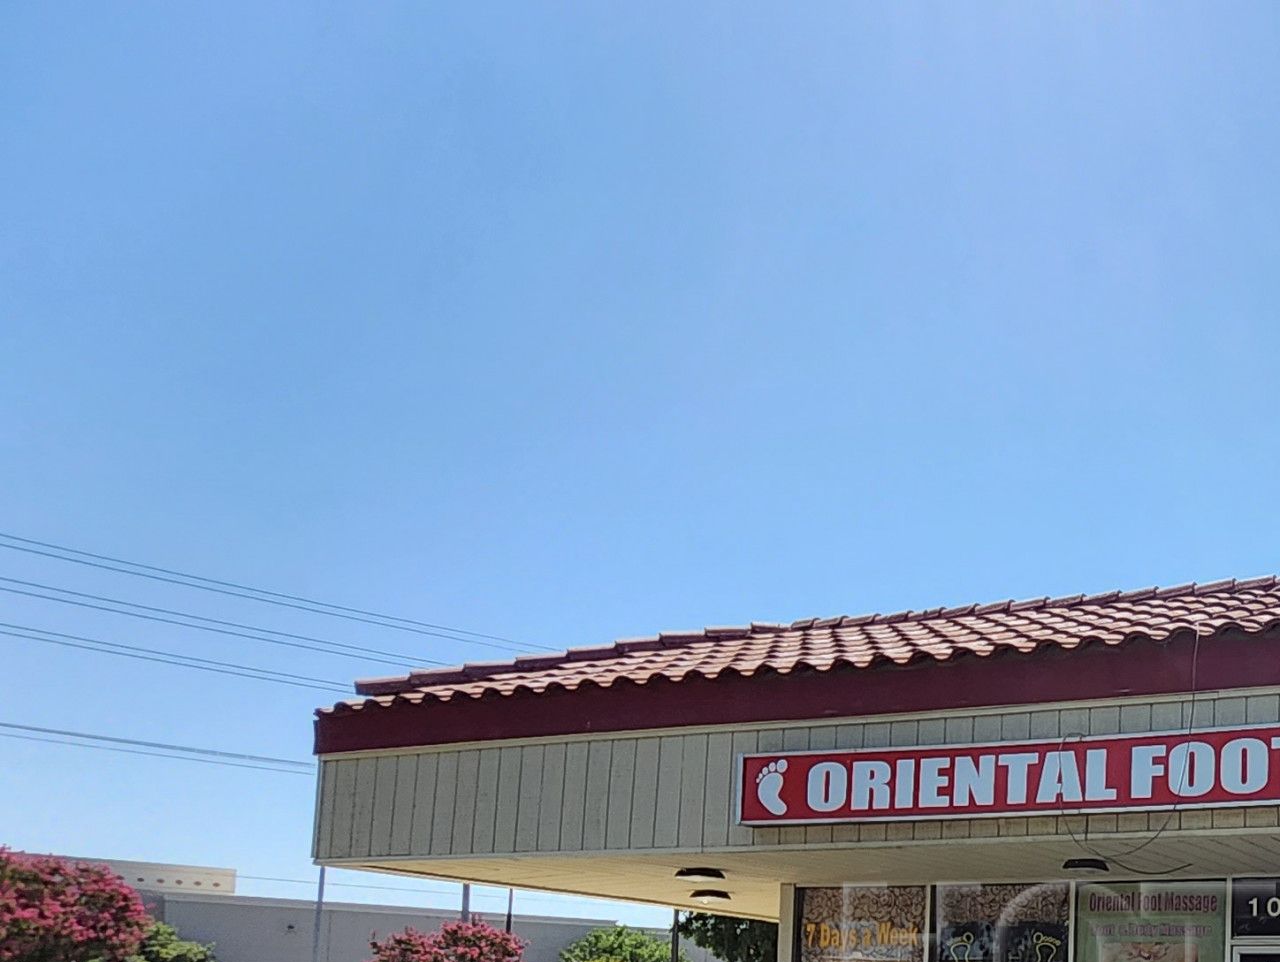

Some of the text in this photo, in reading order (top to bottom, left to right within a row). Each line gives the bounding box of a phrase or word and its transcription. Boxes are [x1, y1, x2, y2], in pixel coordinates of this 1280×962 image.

[807, 749, 1117, 812] ORIENTAL
[1089, 891, 1135, 912] Oriental
[1164, 891, 1218, 912] Massage
[807, 921, 816, 948] 7
[819, 921, 857, 951] Days
[876, 920, 918, 946] Week
